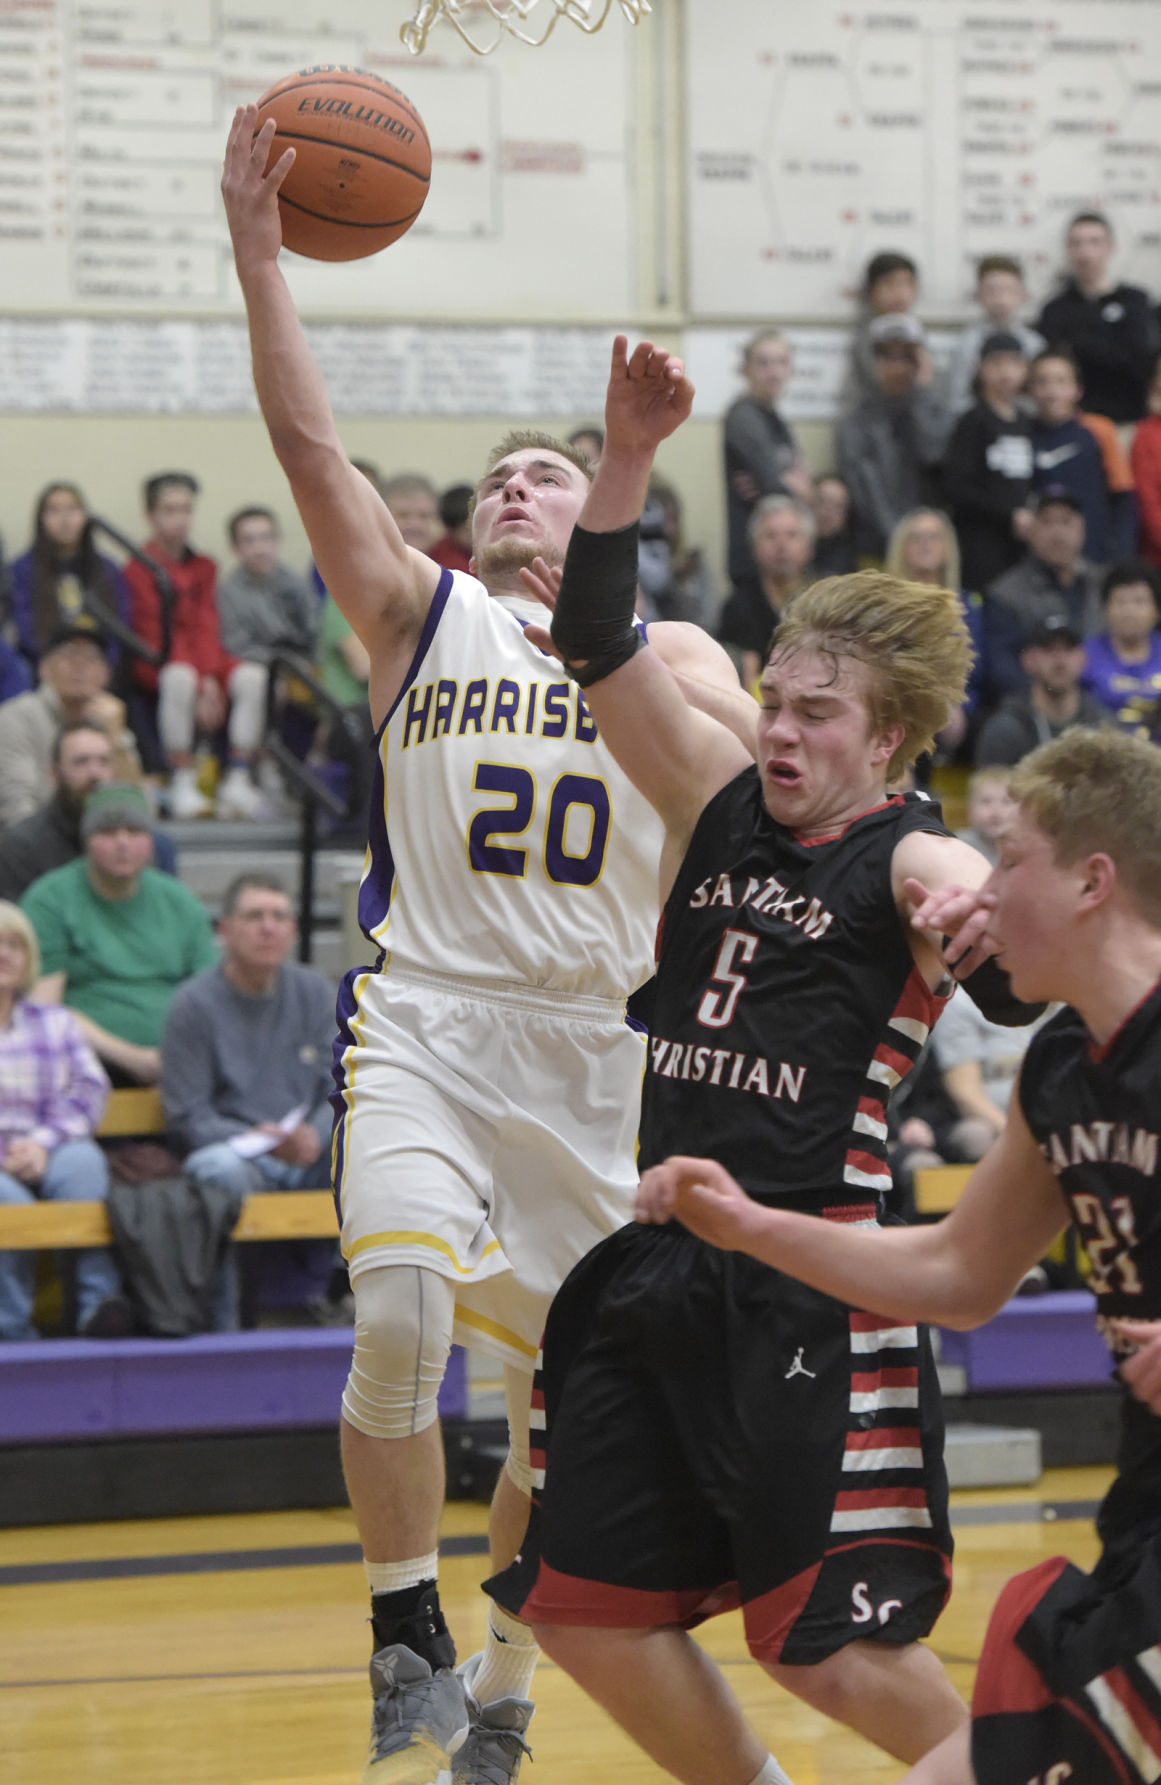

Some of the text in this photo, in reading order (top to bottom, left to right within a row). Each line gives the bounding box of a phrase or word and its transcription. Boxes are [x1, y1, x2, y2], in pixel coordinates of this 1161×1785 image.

[297, 97, 415, 145] EVOLUTION
[465, 759, 613, 889] 20
[696, 926, 760, 1030] 5
